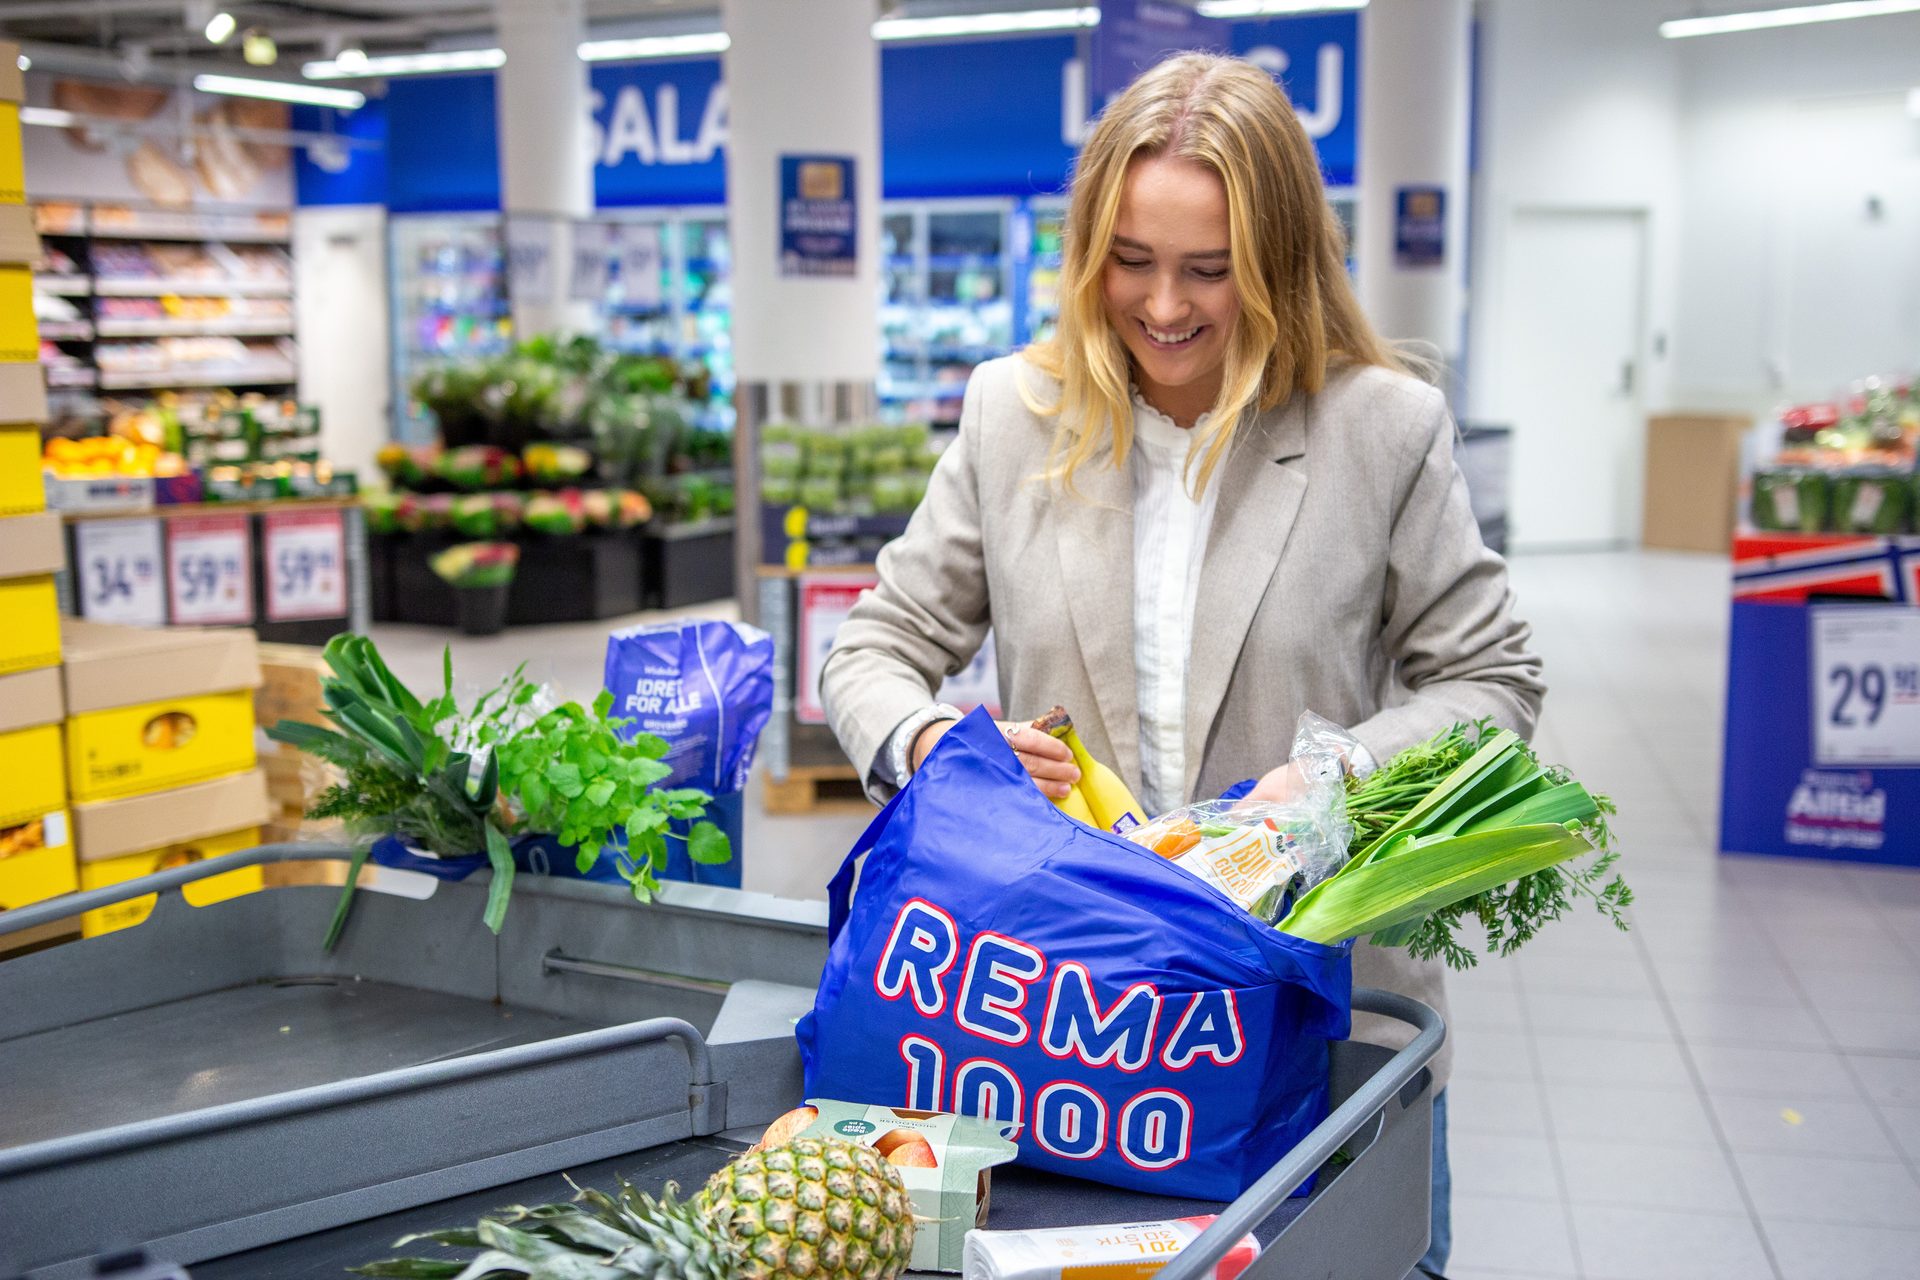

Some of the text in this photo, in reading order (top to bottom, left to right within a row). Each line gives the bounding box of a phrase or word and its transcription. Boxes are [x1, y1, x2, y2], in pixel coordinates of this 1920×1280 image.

[625, 694, 662, 714] FOR
[1828, 663, 1887, 729] 29
[874, 897, 1246, 1073] REMA
[899, 1033, 1194, 1171] 1000
[1096, 1231, 1173, 1247] 30 STK
[1130, 1240, 1181, 1255] 20 L
